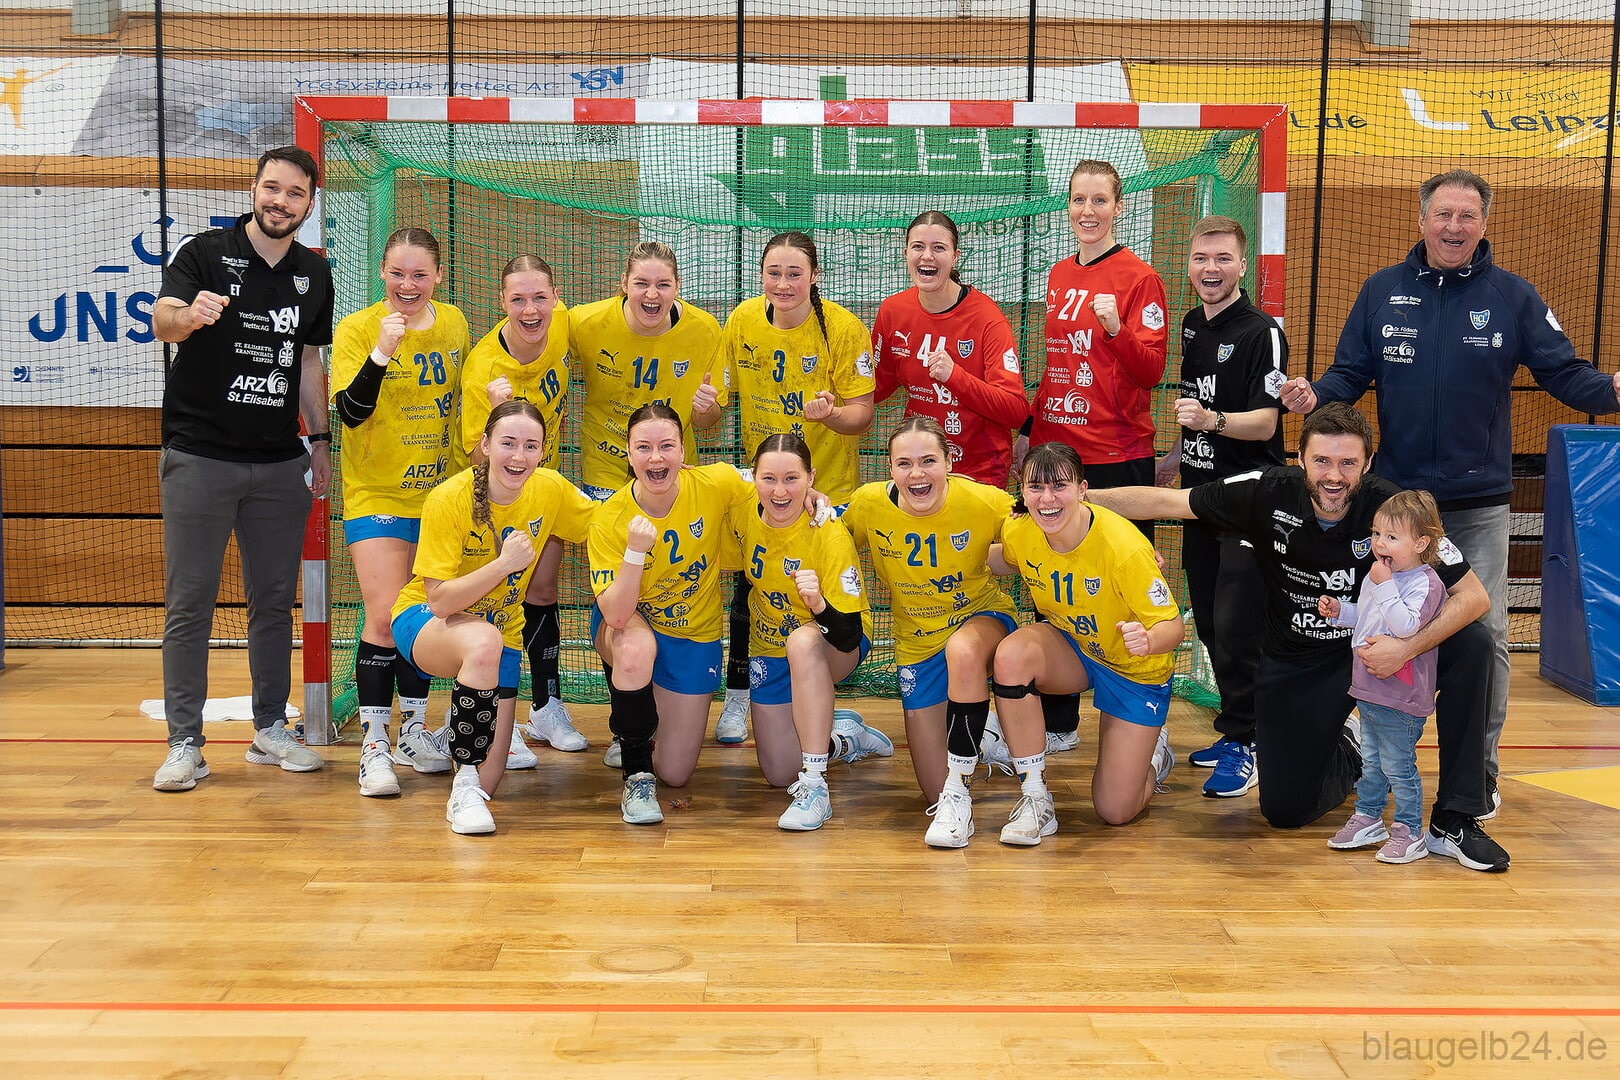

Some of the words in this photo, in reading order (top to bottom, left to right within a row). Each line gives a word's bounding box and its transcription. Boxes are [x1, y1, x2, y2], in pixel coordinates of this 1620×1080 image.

[294, 78, 433, 91] YceSystems
[570, 66, 624, 90] YSN
[1525, 89, 1579, 101] sind
[1481, 110, 1620, 133] Leipz
[230, 284, 241, 297] ET
[1057, 288, 1089, 321] 27
[268, 305, 299, 334] YSN
[1067, 329, 1093, 355] YSN
[1382, 345, 1399, 355] ARZ
[413, 351, 447, 387] 28
[632, 356, 659, 391] 14
[771, 350, 786, 383] 3
[230, 374, 267, 393] ARZ
[539, 368, 561, 405] 18
[242, 393, 285, 408] Elisabeth
[779, 390, 803, 416] YSN
[403, 464, 436, 479] ARZ
[663, 529, 685, 565] 2
[904, 533, 938, 568] 21
[750, 543, 767, 580] 5
[1281, 562, 1320, 581] YceSystems
[1050, 570, 1074, 606] 11
[1318, 567, 1356, 591] YSN
[1067, 614, 1099, 636] YSN
